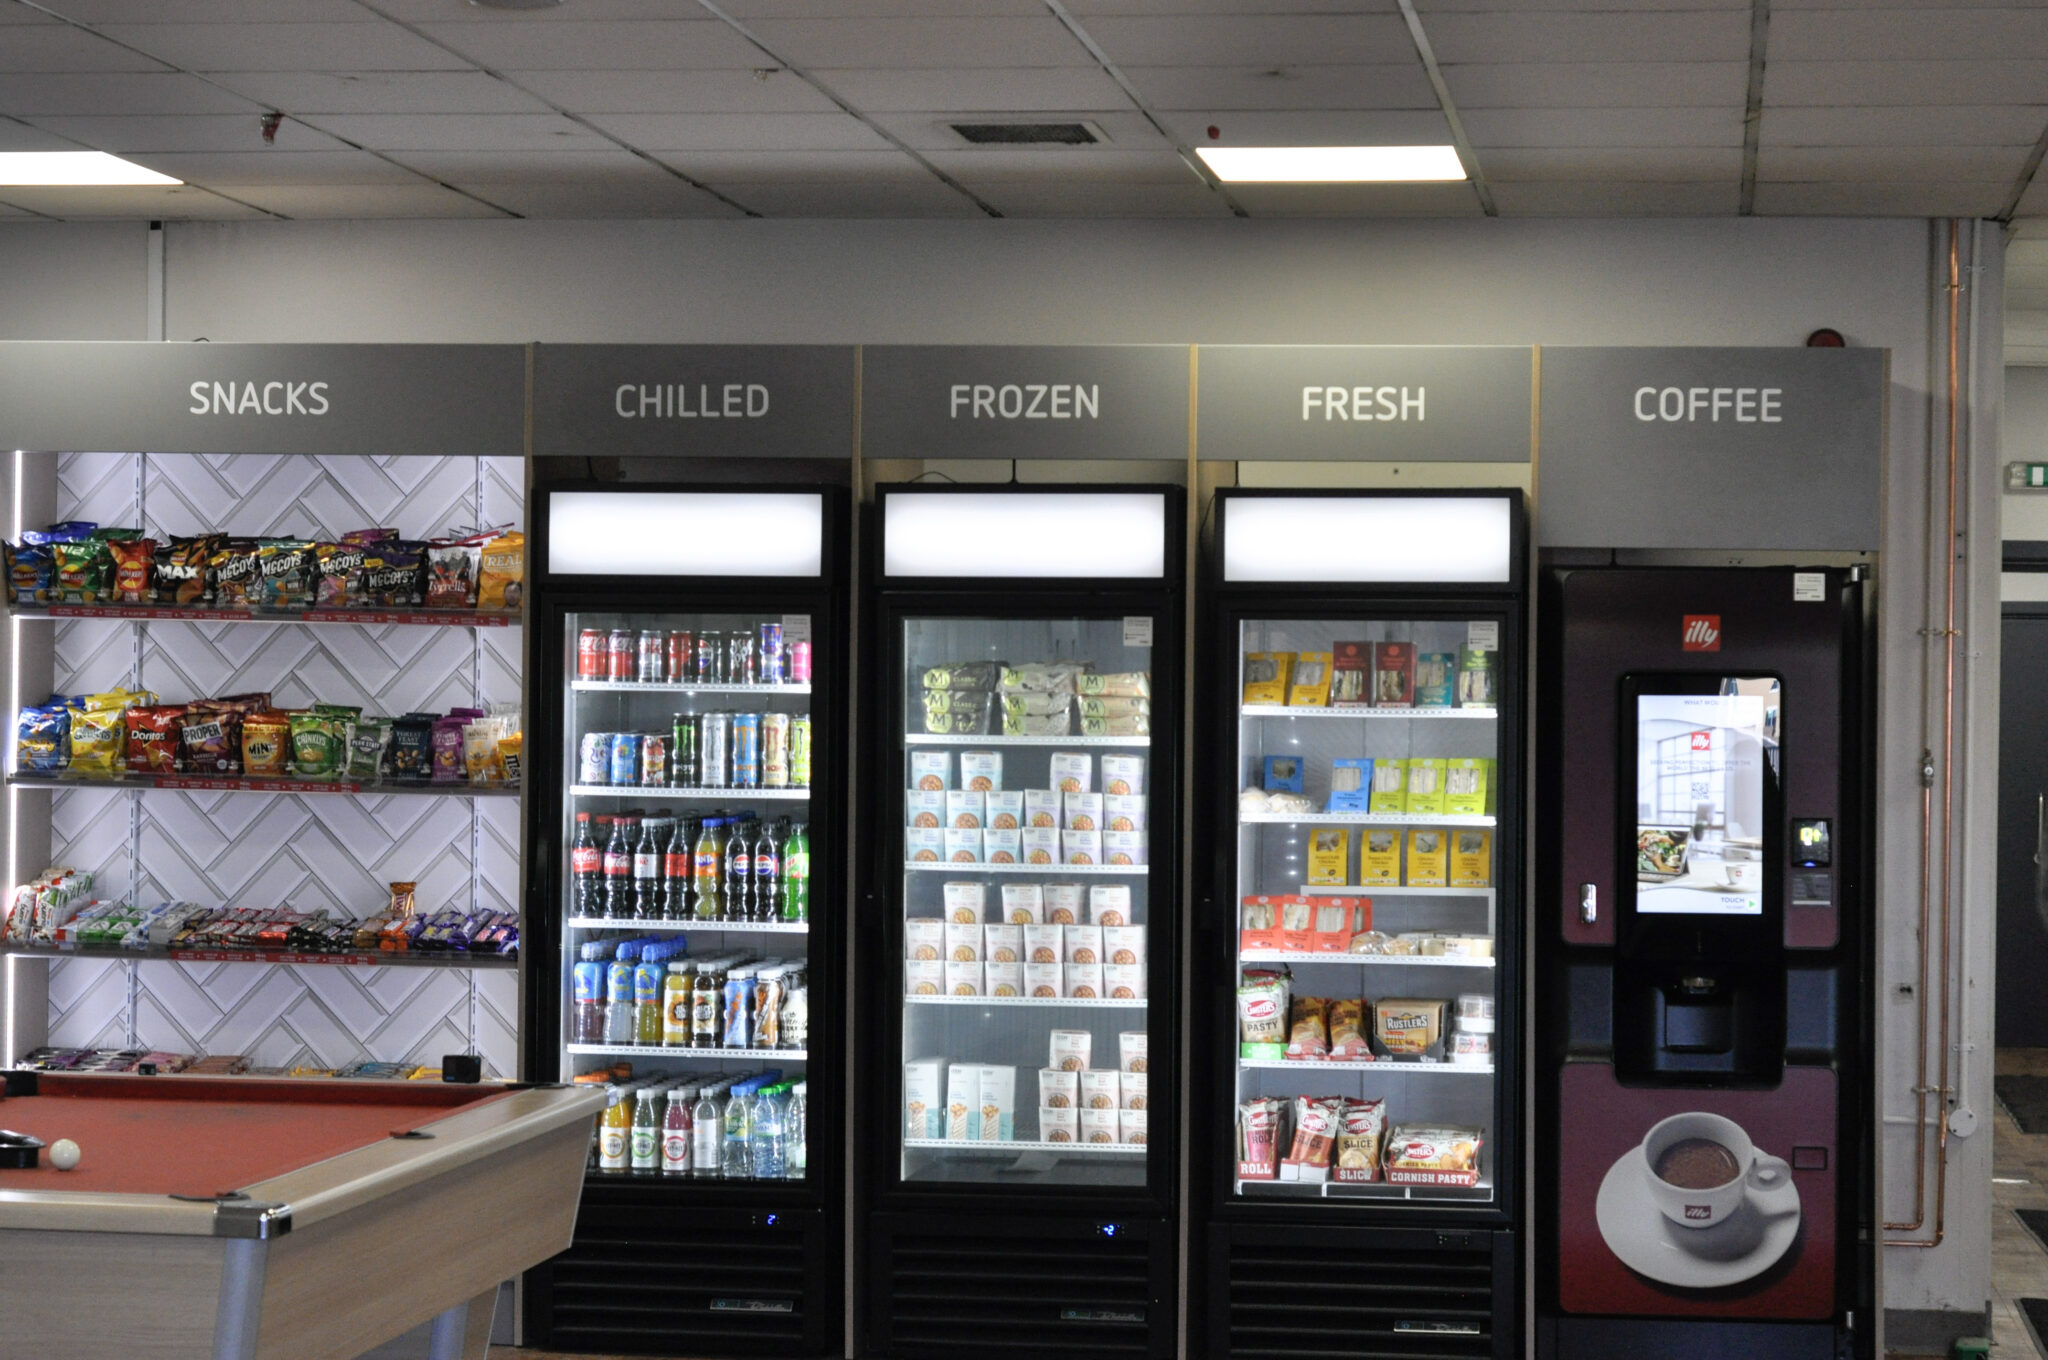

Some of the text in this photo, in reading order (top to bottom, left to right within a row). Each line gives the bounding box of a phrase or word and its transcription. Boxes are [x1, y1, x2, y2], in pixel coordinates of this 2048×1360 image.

[189, 381, 329, 415] SNACKS
[615, 384, 770, 418] CHILLED
[950, 384, 1099, 419] FROZEN
[1302, 386, 1425, 421] FRESH
[1634, 386, 1783, 422] COFFEE
[157, 563, 199, 579] MAX
[1685, 619, 1719, 649] illy
[131, 729, 167, 742] Doritos
[183, 723, 220, 742] PROPER
[1246, 1020, 1279, 1032] PASTY
[1386, 1015, 1428, 1030] RUSTLERS
[1344, 1139, 1374, 1149] SLICE
[1240, 1163, 1272, 1175] ROLL
[1391, 1172, 1471, 1185] CORNISH PASTY
